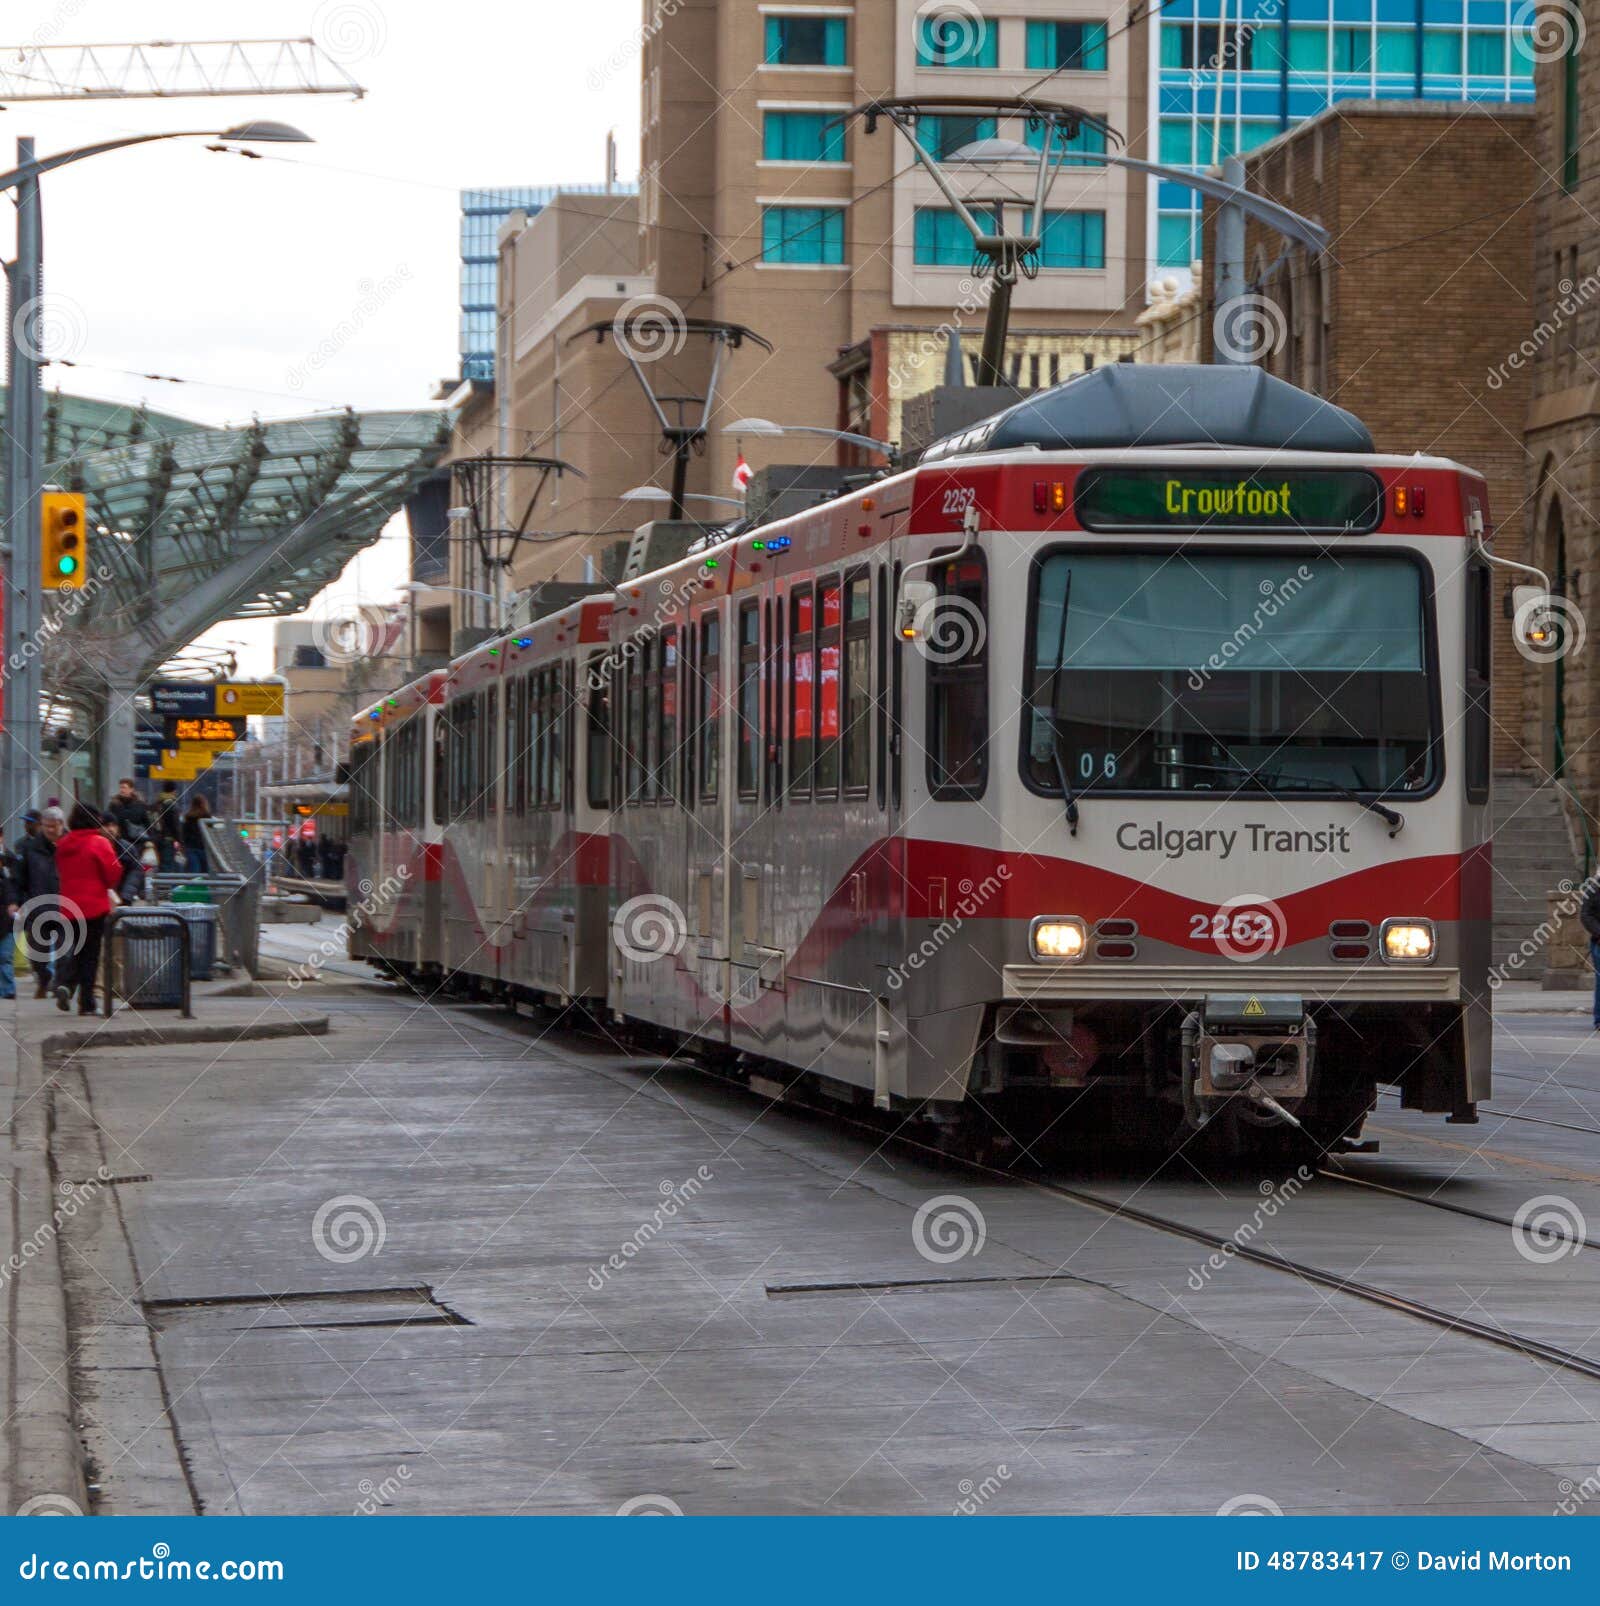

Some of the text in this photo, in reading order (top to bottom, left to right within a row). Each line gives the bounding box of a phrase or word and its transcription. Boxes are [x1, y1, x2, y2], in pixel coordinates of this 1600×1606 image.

[942, 486, 975, 513] 2252
[1165, 480, 1291, 515] Crowfoot
[1116, 822, 1350, 859] Calgary Transit
[1189, 914, 1273, 940] 2252
